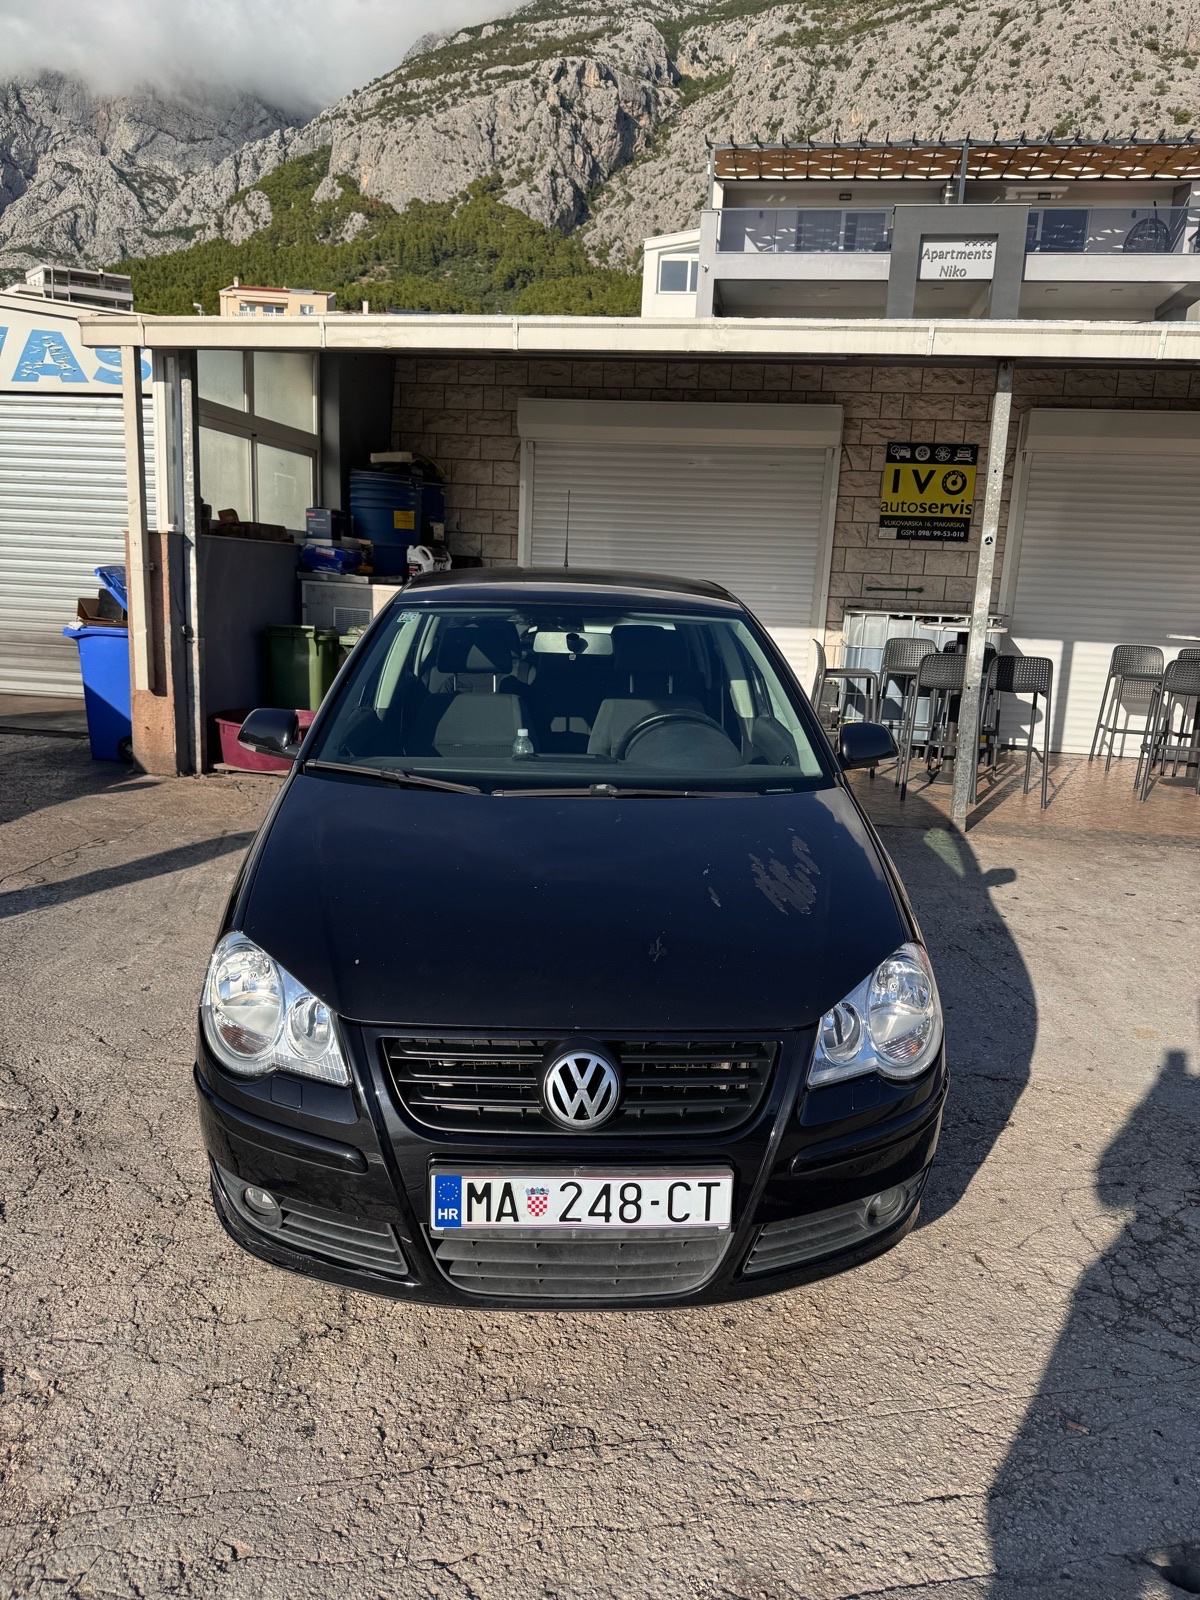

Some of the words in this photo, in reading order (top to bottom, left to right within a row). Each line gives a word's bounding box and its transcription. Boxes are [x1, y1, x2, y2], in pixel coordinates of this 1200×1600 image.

[922, 247, 993, 262] Apartments
[939, 264, 967, 277] Niko
[892, 469, 967, 495] IVO
[880, 499, 973, 515] autoservis
[466, 1181, 519, 1222] MA
[558, 1181, 721, 1223] 248-CT
[437, 1208, 459, 1220] HR
